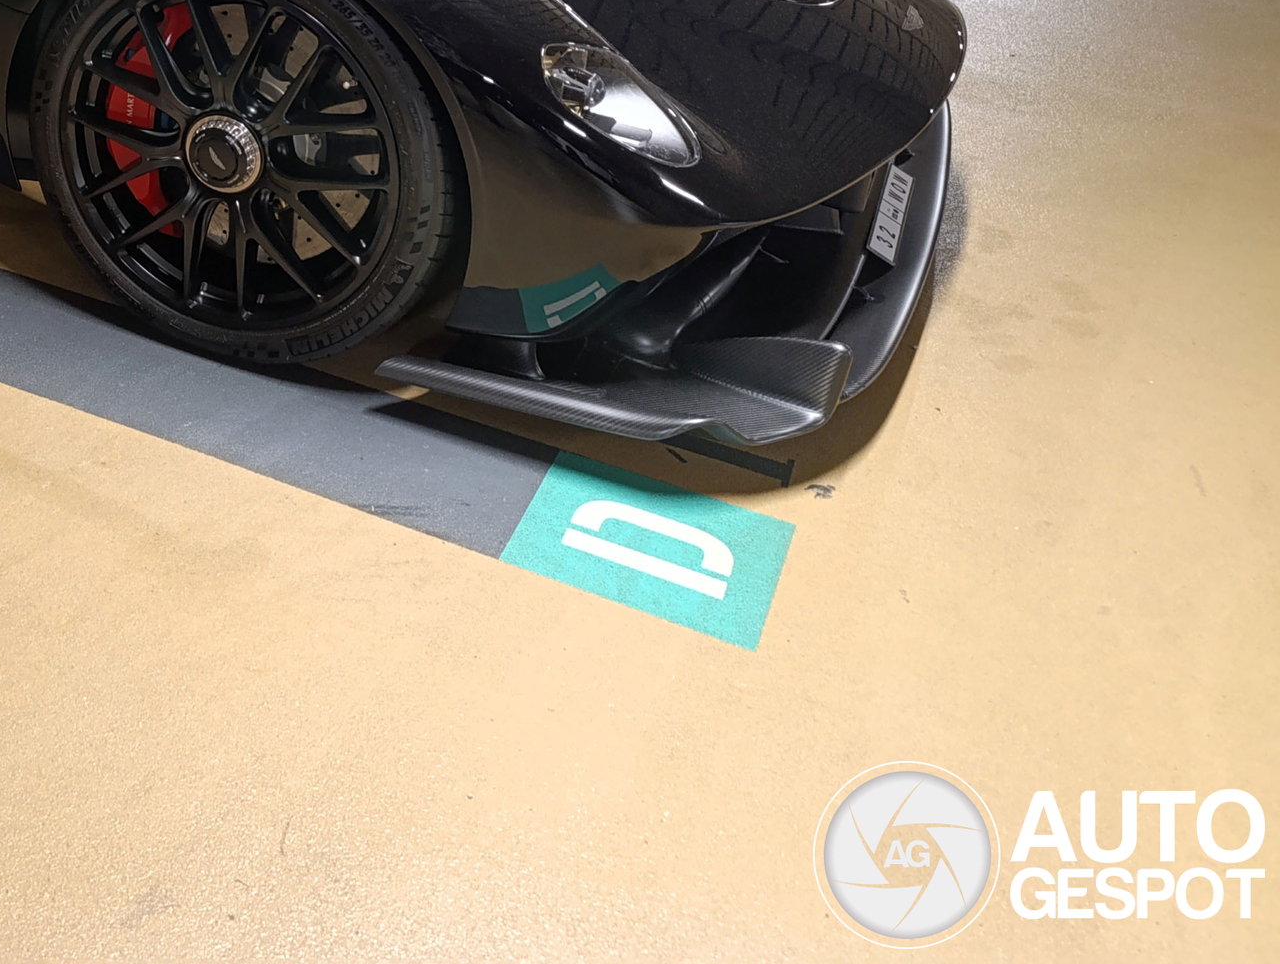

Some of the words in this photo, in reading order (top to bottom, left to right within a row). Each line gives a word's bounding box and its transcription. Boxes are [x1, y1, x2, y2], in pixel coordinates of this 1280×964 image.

[126, 92, 135, 117] MART
[876, 224, 896, 249] 32
[887, 172, 909, 204] WOW
[286, 286, 394, 356] MICHELIN
[561, 500, 734, 600] D
